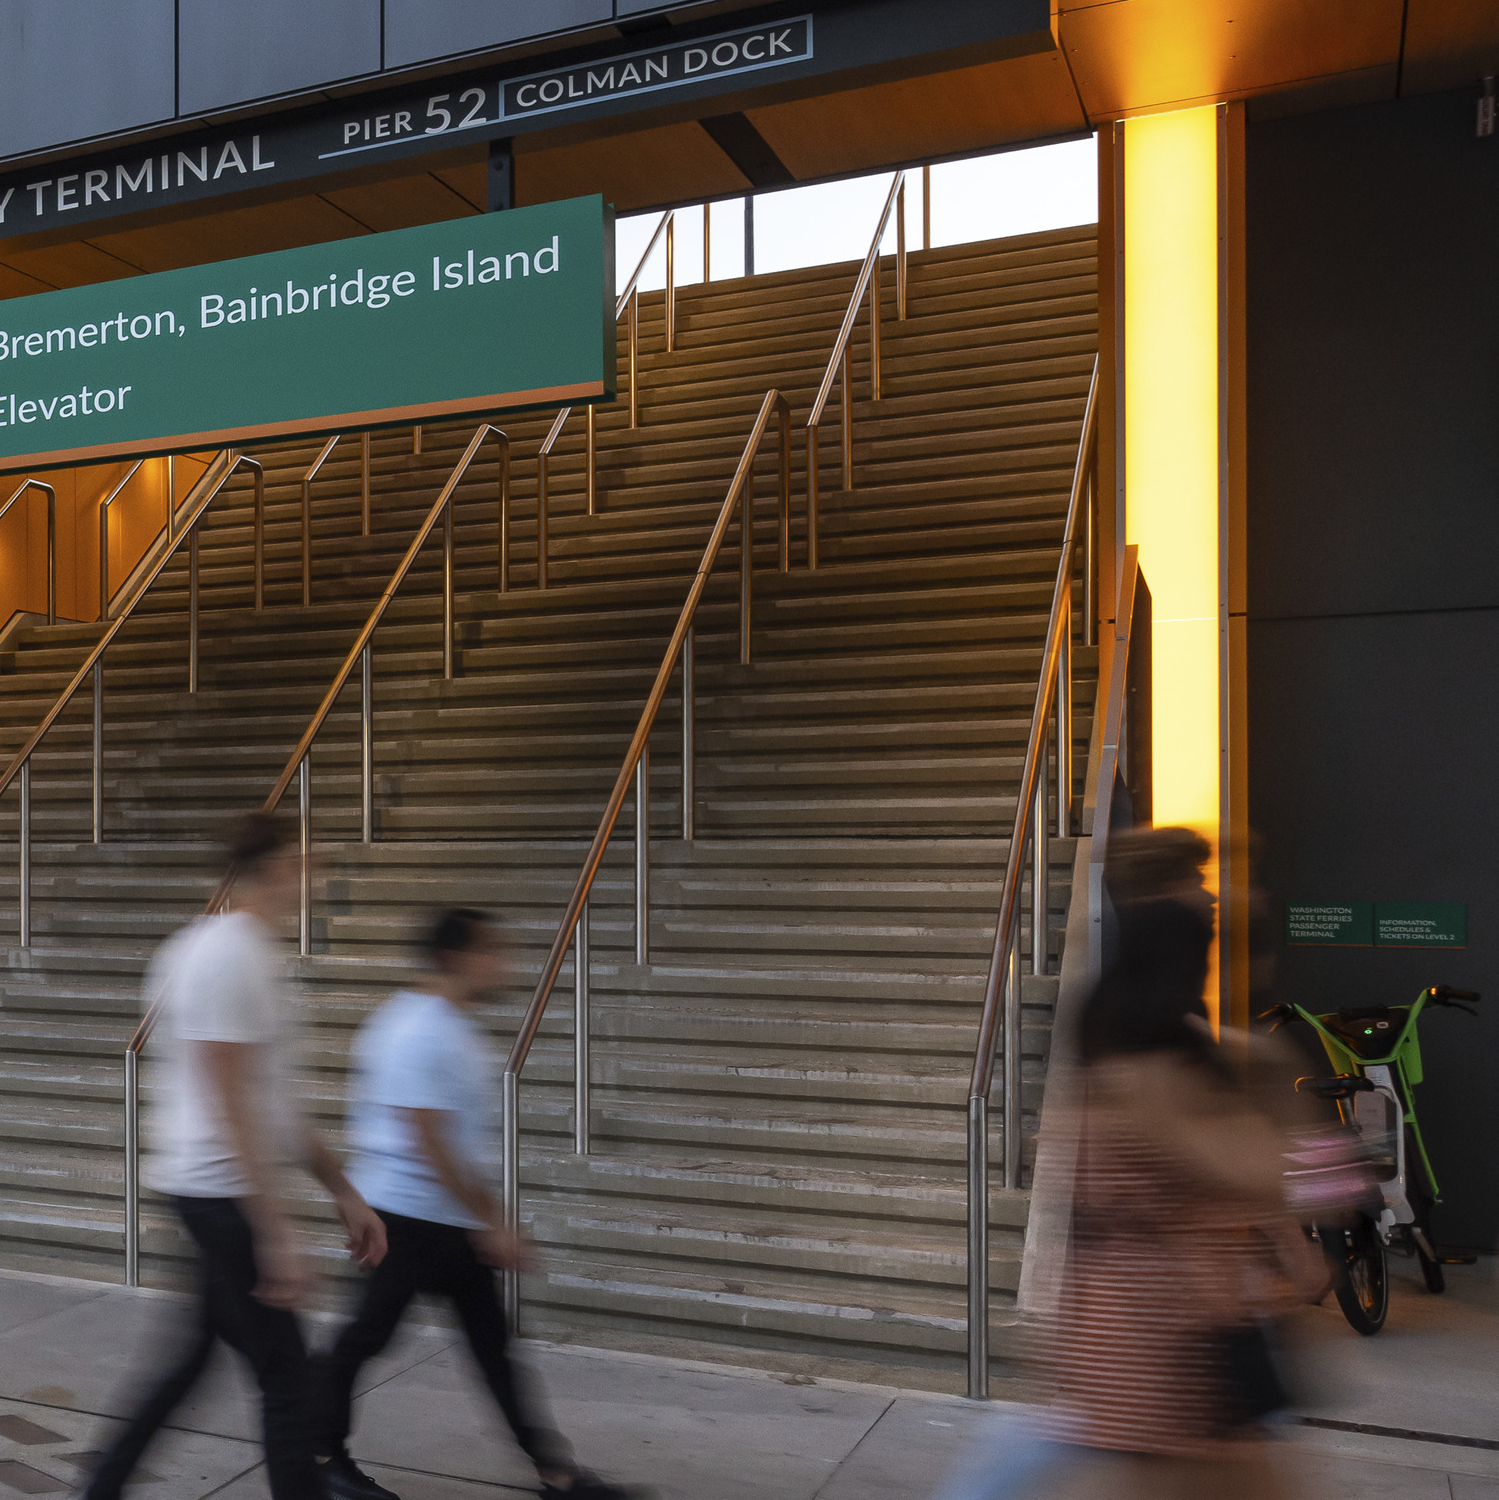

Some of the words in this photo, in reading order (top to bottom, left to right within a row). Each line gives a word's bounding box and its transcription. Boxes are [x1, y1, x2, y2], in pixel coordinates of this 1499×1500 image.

[343, 111, 413, 145] PIER
[424, 88, 487, 135] 52
[516, 55, 669, 108] COLMAN
[683, 28, 793, 75] DOCK
[26, 135, 276, 216] TERMINAL
[200, 268, 416, 330] Bainbridge
[433, 235, 560, 292] Island
[1289, 914, 1316, 922] STATE
[1289, 922, 1340, 930] PASSENGER
[1290, 930, 1336, 938] TERMINAL
